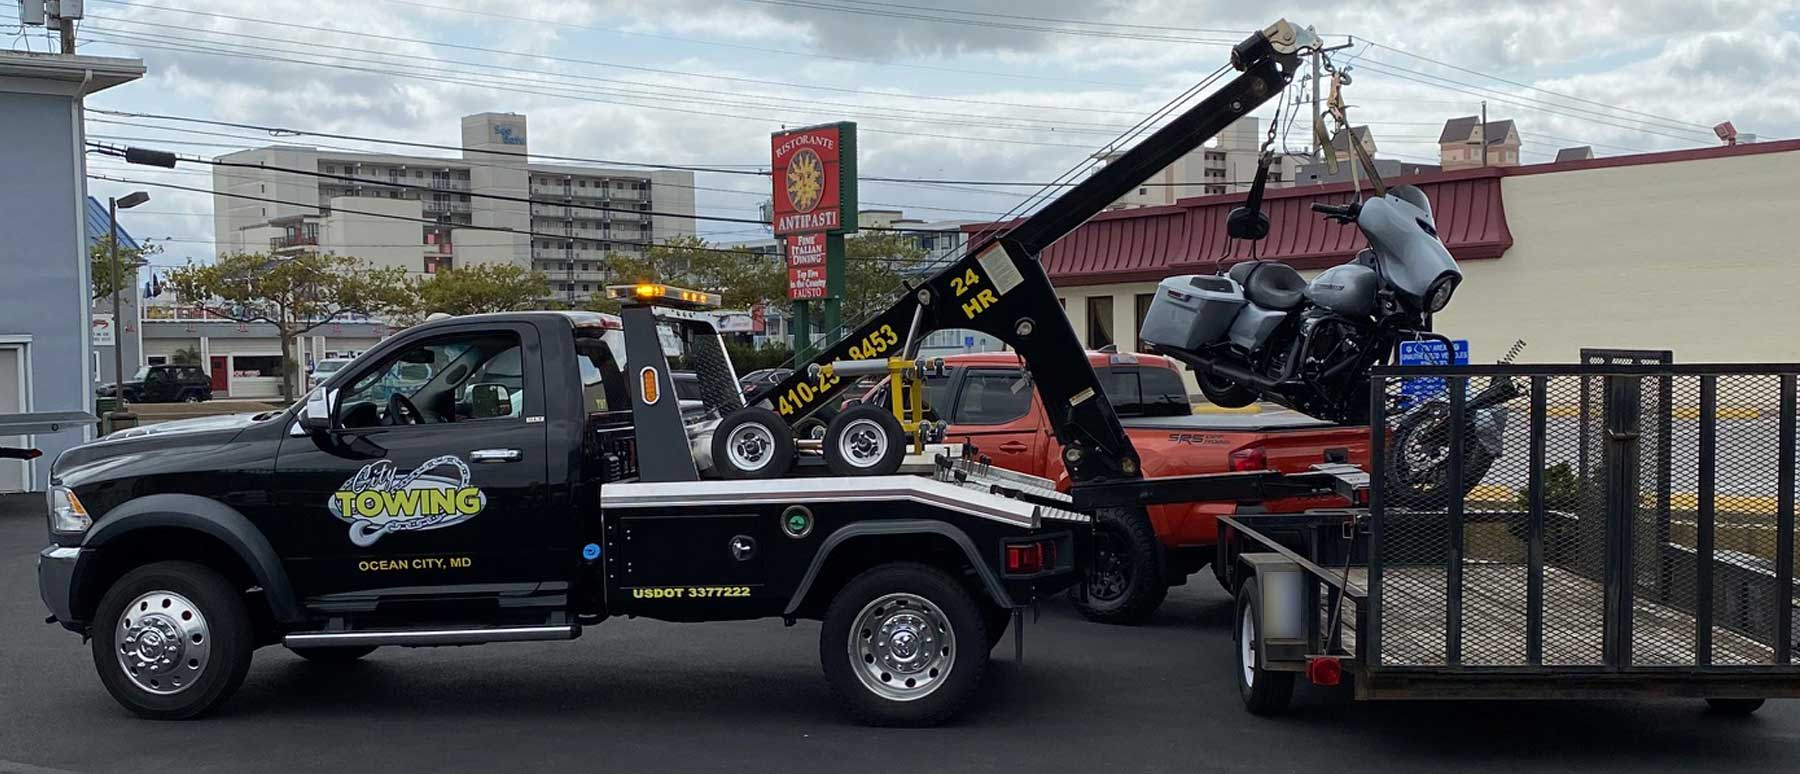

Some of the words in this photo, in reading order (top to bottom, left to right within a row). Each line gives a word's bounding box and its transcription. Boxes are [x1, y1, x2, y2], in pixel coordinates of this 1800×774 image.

[775, 135, 834, 158] RISTORANTE
[779, 211, 836, 231] ANTIPASTI
[791, 244, 822, 256] ITALIAN
[792, 253, 822, 265] DINING
[796, 269, 806, 281] Top
[950, 267, 980, 297] 24
[793, 287, 822, 299] FAUSTO
[961, 288, 998, 320] HR
[352, 459, 398, 495] City
[335, 486, 481, 517] TOWING
[358, 559, 408, 571] OCEAN
[412, 558, 447, 570] CITY,
[450, 557, 472, 568] MD
[633, 588, 684, 599] USDOT
[688, 587, 751, 598] 3377222
